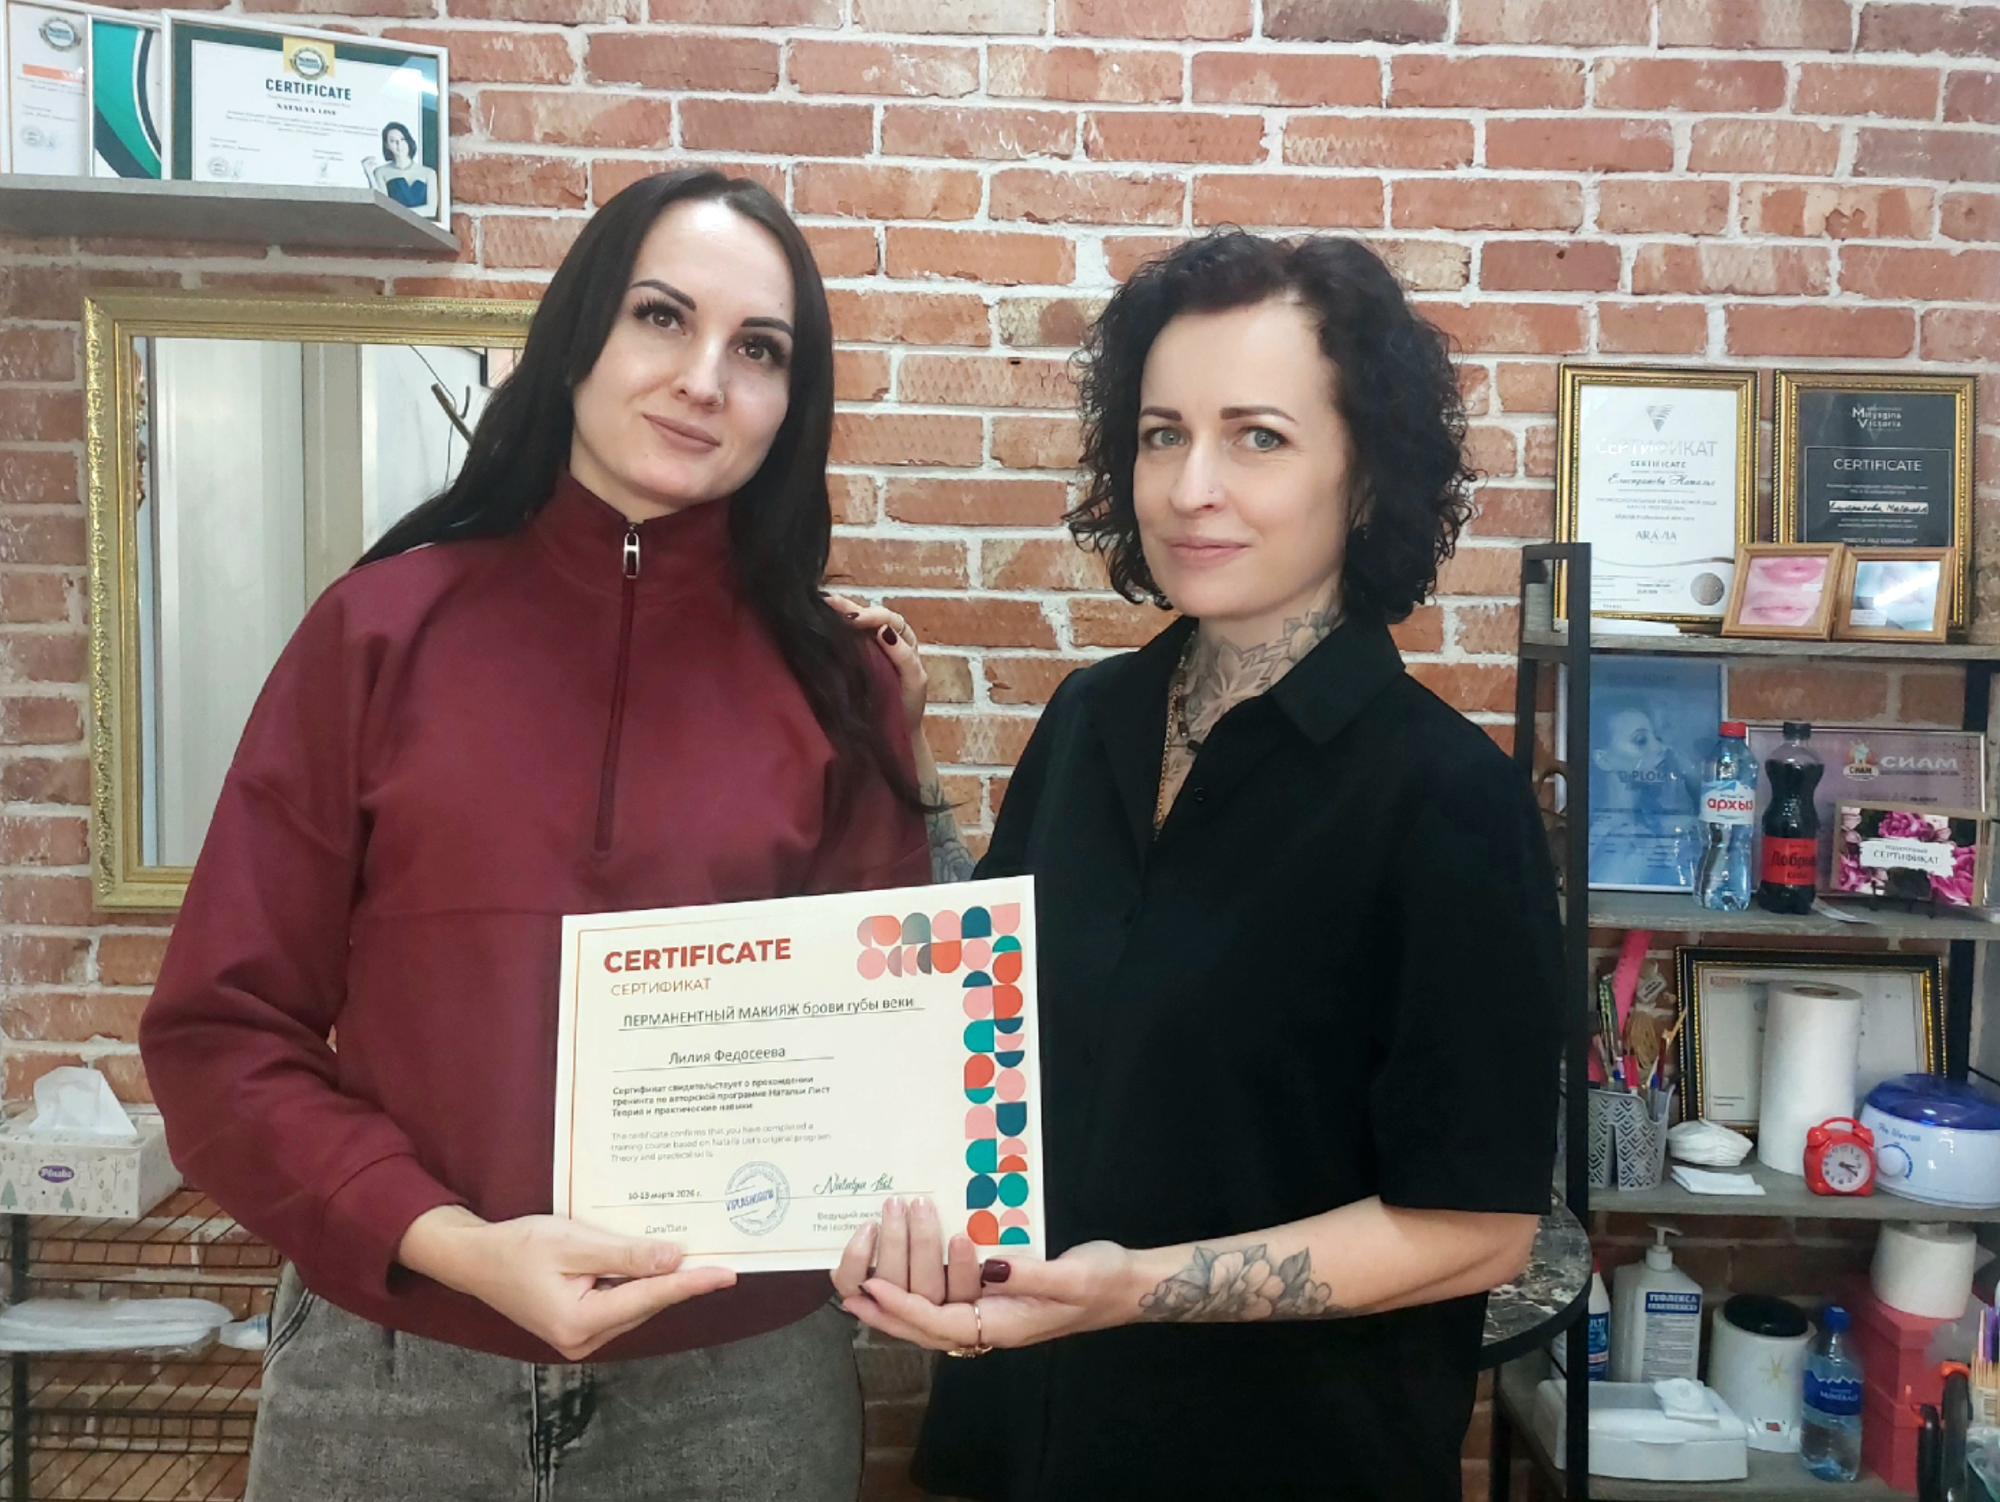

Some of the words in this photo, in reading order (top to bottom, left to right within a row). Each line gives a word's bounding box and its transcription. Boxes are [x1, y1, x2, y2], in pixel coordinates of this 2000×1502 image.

[265, 78, 352, 101] CERTIFICATE
[1630, 460, 1687, 468] CERTIFICATE
[1833, 459, 1923, 471] CERTIFICATE
[1873, 849, 1939, 864] СЕРТИФИКАТ
[604, 938, 791, 973] CERTIFICATE
[611, 978, 712, 996] СЕРТИФИКАТ
[623, 1005, 735, 1027] ПЕРМАНЕНТНЫЙ
[739, 1002, 799, 1020] МАКИЯЖ
[802, 1001, 844, 1018] брови
[848, 997, 879, 1014] губы
[882, 997, 914, 1009] веки
[669, 1051, 711, 1064] Лилия
[714, 1047, 786, 1062] Федосеева
[612, 1086, 666, 1096] Сертификат
[668, 1080, 742, 1092] свидетельствует
[752, 1077, 814, 1087] прохождении
[612, 1097, 654, 1106] тренинга
[669, 1092, 716, 1103] авторской
[717, 1090, 767, 1100] программе
[808, 1086, 831, 1095] Лист
[612, 1108, 644, 1118] Теория
[654, 1104, 718, 1116] практические
[719, 1103, 753, 1112] навыки
[673, 1140, 697, 1149] based
[640, 1152, 656, 1160] and
